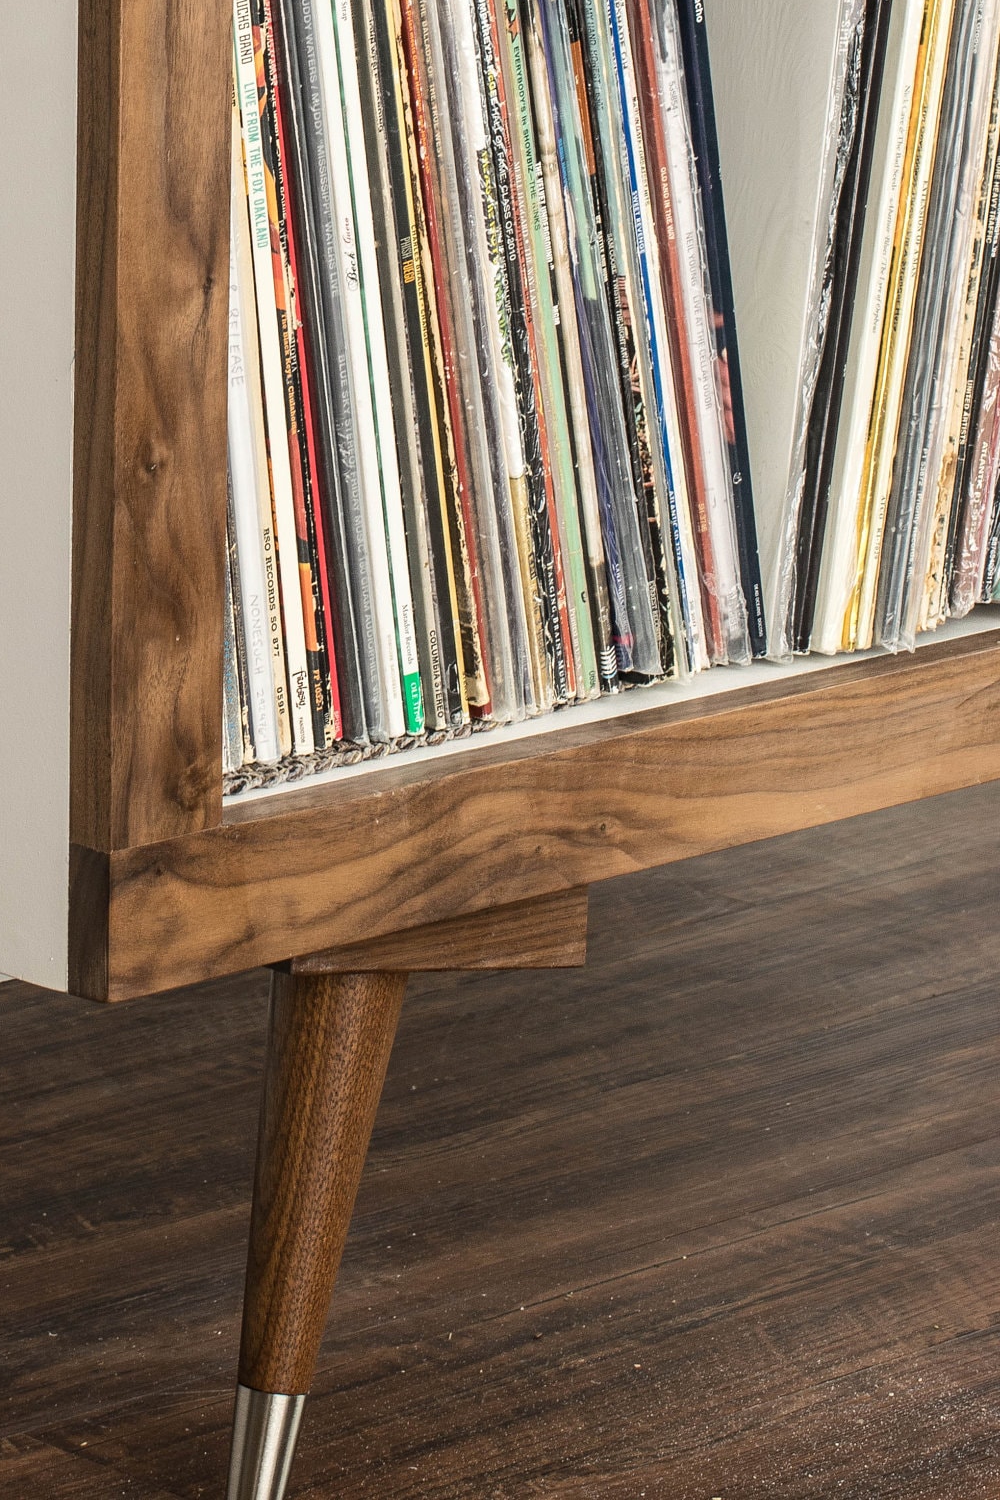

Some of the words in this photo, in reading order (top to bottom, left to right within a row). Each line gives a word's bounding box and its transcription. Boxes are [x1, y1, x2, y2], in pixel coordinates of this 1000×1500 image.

[339, 1, 349, 21] Strap
[404, 10, 413, 31] Dylan
[238, 33, 253, 65] BAND
[407, 31, 416, 53] meets
[420, 19, 433, 63] BALLADS
[971, 22, 982, 54] Groove
[305, 33, 318, 82] WATERS
[409, 54, 419, 80] George
[426, 66, 434, 78] OF
[512, 46, 528, 112] EVERYBODY'S
[243, 82, 256, 106] LIVE
[413, 80, 424, 112] Harrison
[428, 83, 437, 102] THE
[902, 85, 912, 103] Nick
[246, 111, 259, 141] FROM
[310, 92, 323, 136] MUDDY
[490, 106, 502, 131] HALL
[898, 105, 909, 125] Cave
[433, 131, 443, 159] WEST
[492, 135, 504, 149] OF
[895, 135, 906, 150] The
[248, 146, 262, 167] THE
[494, 152, 509, 184] FAME:
[534, 161, 543, 177] THE
[892, 151, 904, 167] Bad
[250, 171, 264, 193] FOX
[513, 161, 523, 194] MERLE
[658, 166, 668, 181] OLD
[889, 168, 900, 191] Seeds
[499, 184, 514, 219] CLASS
[535, 177, 546, 204] VELVET
[631, 190, 641, 215] SWEET
[660, 182, 670, 198] AND
[989, 181, 1000, 208] HEAVY
[517, 195, 528, 237] HAGGARD
[663, 199, 671, 208] IN
[915, 179, 929, 232] EXTENSION
[253, 197, 269, 248] OAKLAND
[504, 220, 515, 235] OF
[664, 209, 673, 224] THE
[985, 209, 996, 244] TRAFFIC
[410, 224, 419, 261] CHARLES
[607, 232, 615, 249] SAM
[634, 217, 645, 253] REVENGE
[666, 224, 676, 240] WAY
[684, 231, 695, 252] NEIL
[914, 234, 921, 245] OF
[324, 221, 337, 269] WATERS
[398, 236, 413, 259] PHISH
[506, 237, 518, 262] 2010
[523, 247, 532, 265] THE
[881, 236, 891, 255] Blues
[343, 251, 359, 291] Beck
[401, 259, 416, 284] FUEGO
[609, 249, 619, 274] COOKE
[687, 254, 699, 286] YOUNG
[909, 258, 917, 278] MAN
[329, 272, 340, 298] LIVE
[414, 263, 424, 301] BRADLEY
[525, 266, 534, 286] WAY
[528, 293, 537, 309] AM
[691, 294, 702, 314] LIVE
[281, 313, 289, 330] The
[551, 304, 560, 325] MGM
[694, 316, 704, 328] AT
[420, 308, 429, 348] CHANGES
[616, 323, 625, 345] NIGHT
[695, 330, 706, 347] THE
[282, 332, 291, 356] Black
[284, 358, 293, 379] Keys
[337, 354, 348, 386] BLUE
[697, 348, 709, 382] CELLAR
[340, 390, 351, 413] SKY
[702, 384, 712, 410] DOOR
[963, 379, 974, 409] UNITED
[287, 385, 298, 436] Chulahoma
[958, 409, 970, 445] ARTISTS
[975, 440, 988, 489] ATLANTIC
[349, 471, 361, 511] FRIDAY
[668, 490, 678, 527] ATLANTIC
[912, 492, 922, 524] Priority
[261, 527, 272, 551] RSO
[353, 514, 365, 552] MUSIC
[263, 556, 277, 611] RECORDS
[360, 575, 371, 611] GRAM
[753, 583, 761, 596] DEAD
[754, 596, 762, 616] OCEANS
[269, 615, 279, 632] SO
[400, 603, 412, 635] Matador
[248, 593, 264, 675] NONESUCH
[551, 617, 563, 656] BRAINS
[271, 637, 281, 657] 877
[404, 636, 415, 665] Records
[428, 629, 441, 680] COLUMBIA
[291, 666, 308, 708] Fantasy
[409, 681, 419, 700] OLE
[555, 659, 568, 697] MUSIC
[433, 681, 444, 718] STEREO
